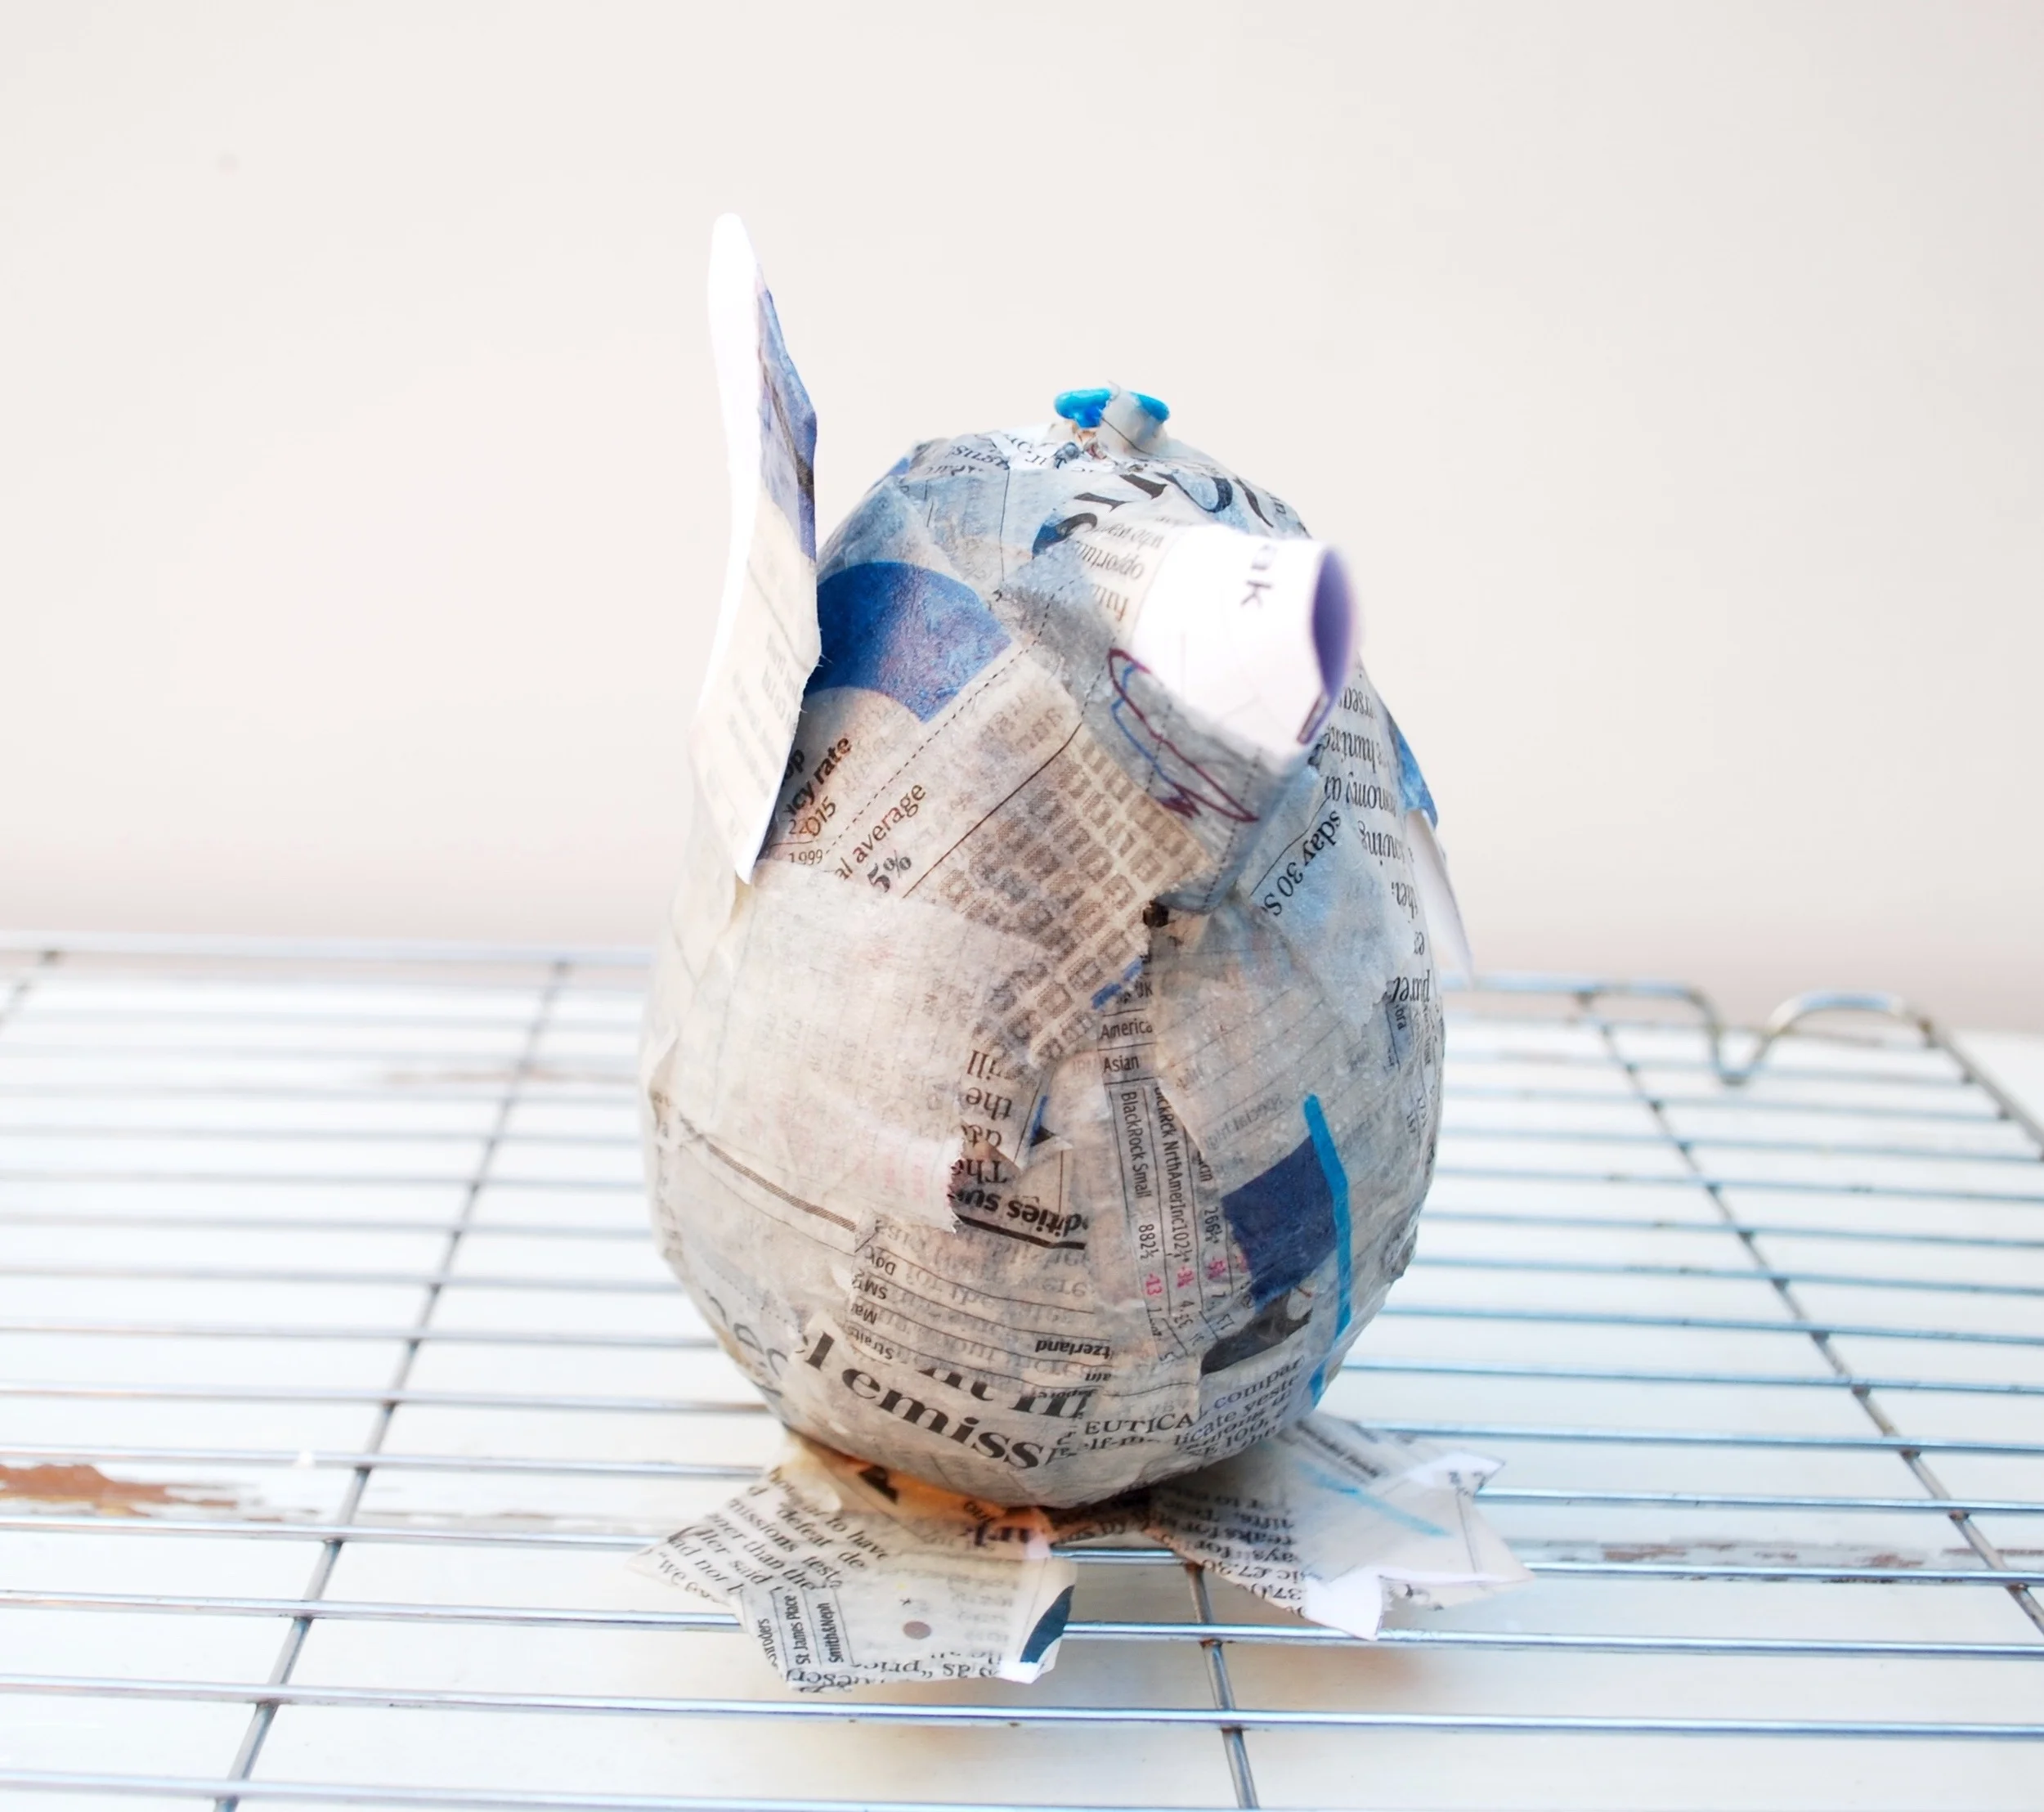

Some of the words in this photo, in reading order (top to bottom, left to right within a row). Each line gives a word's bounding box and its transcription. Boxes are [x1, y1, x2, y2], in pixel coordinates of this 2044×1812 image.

[814, 738, 852, 785] rate
[853, 784, 926, 863] average
[788, 849, 823, 865] 1999
[867, 850, 912, 893] 5%
[1277, 861, 1305, 899] 30
[1104, 1053, 1139, 1074] Asian
[966, 1087, 1013, 1121] the
[1121, 1091, 1146, 1161] BlackRock
[951, 1158, 1008, 1183] The
[1132, 1163, 1152, 1199] Small
[826, 1515, 848, 1532] to
[695, 1559, 729, 1583] not
[729, 1560, 774, 1585] said
[743, 1541, 785, 1569] than
[782, 1568, 816, 1590] the
[784, 1594, 799, 1621] Place
[791, 1622, 809, 1653] James
[816, 1601, 845, 1664] Smith&Neph
[796, 1655, 811, 1666] St
